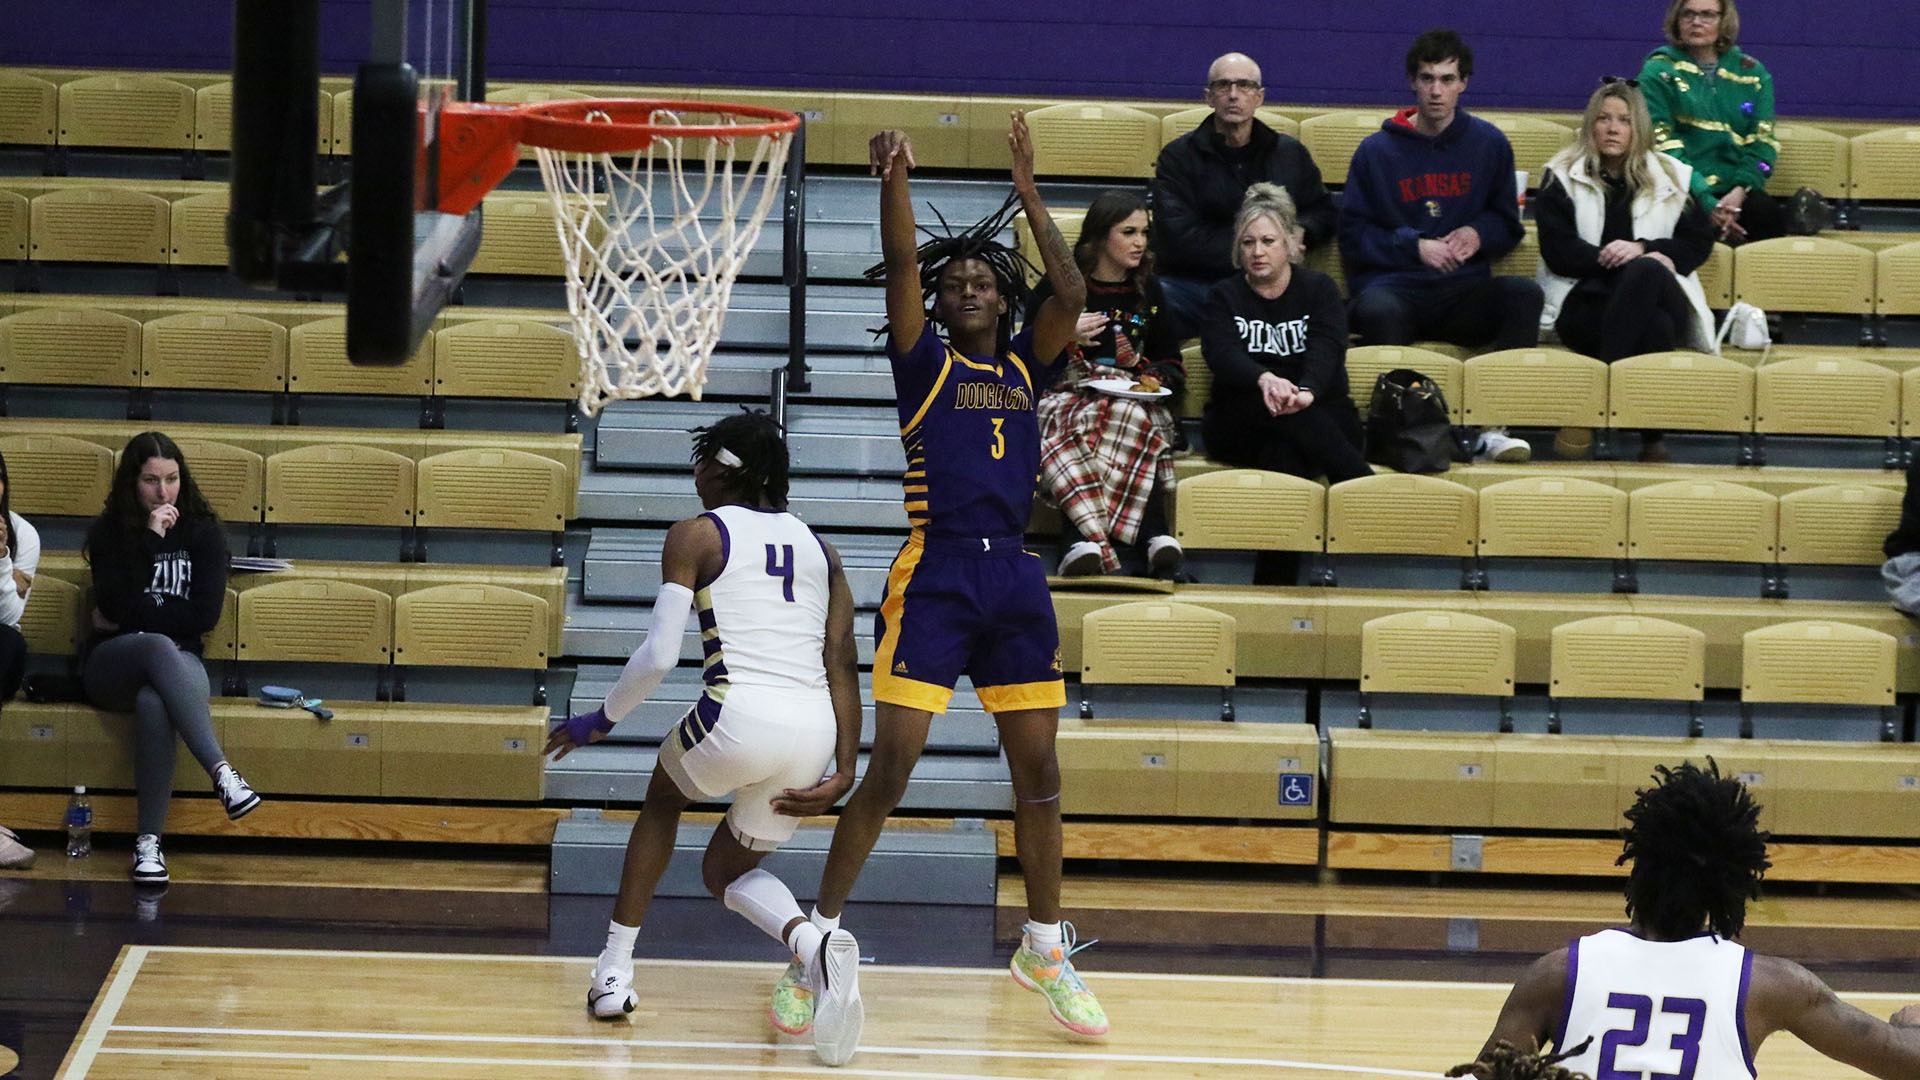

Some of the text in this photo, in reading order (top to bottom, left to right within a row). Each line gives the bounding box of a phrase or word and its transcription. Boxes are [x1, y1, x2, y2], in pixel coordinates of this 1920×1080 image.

[1398, 172, 1471, 203] KANSAS
[955, 382, 1005, 410] DODGE
[991, 418, 1005, 460] 3
[765, 544, 795, 602] 4
[1597, 991, 1707, 1080] 23
